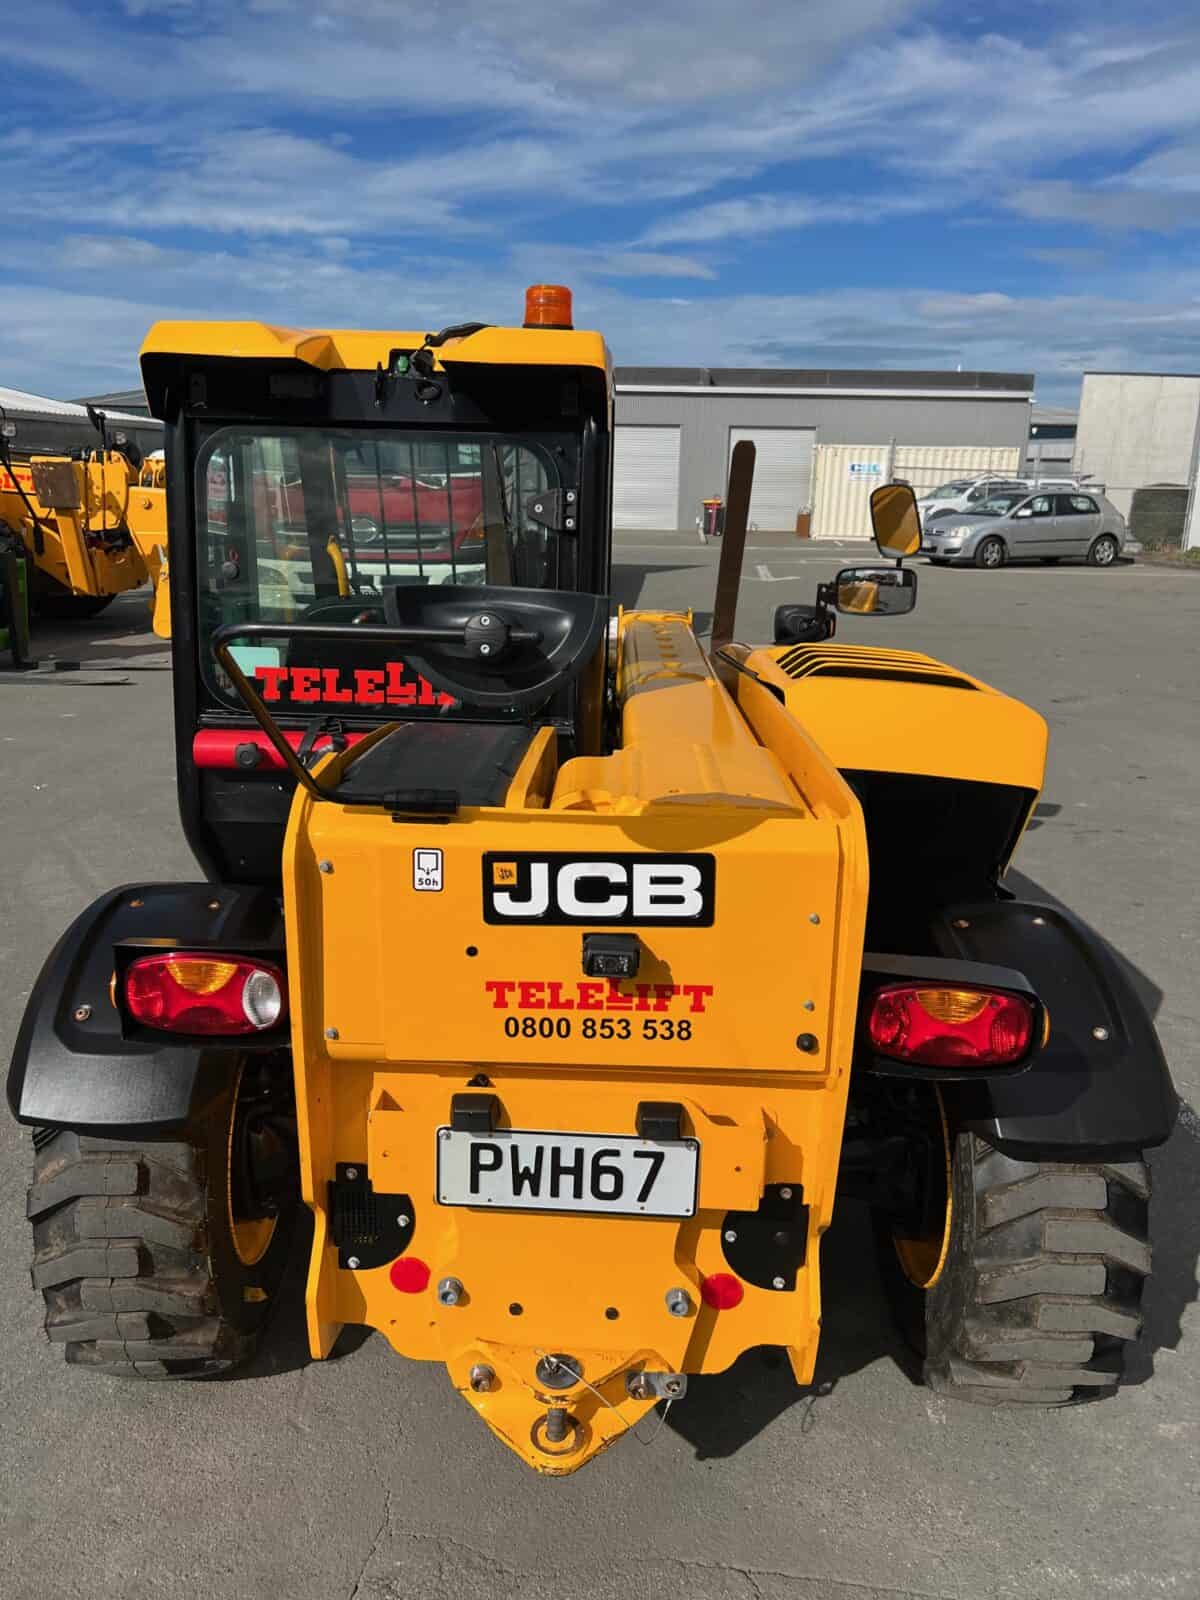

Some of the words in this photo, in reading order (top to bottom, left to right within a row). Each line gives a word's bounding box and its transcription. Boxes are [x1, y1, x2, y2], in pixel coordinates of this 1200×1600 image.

[255, 662, 456, 705] TELELI
[418, 878, 438, 886] 50h
[493, 862, 703, 917] JCB
[486, 978, 713, 1012] TELELIFT
[505, 1017, 571, 1038] 0800
[582, 1018, 631, 1039] 853
[643, 1019, 692, 1041] 538
[470, 1142, 665, 1203] PWH67
